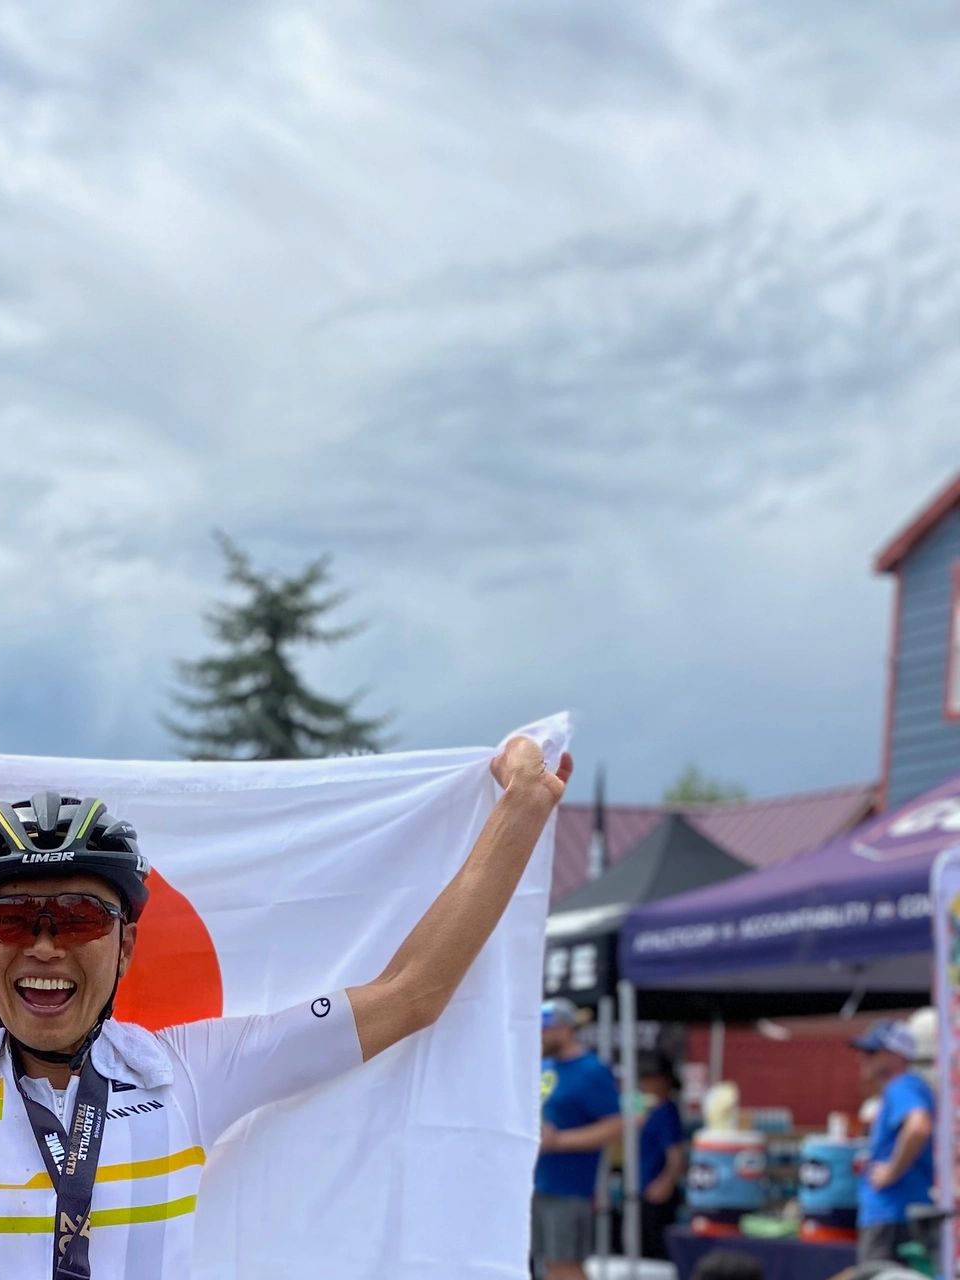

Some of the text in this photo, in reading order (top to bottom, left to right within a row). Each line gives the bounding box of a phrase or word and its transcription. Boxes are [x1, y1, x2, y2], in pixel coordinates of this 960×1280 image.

[21, 851, 75, 865] LIMAR
[73, 1103, 87, 1133] TRAIL
[106, 1099, 165, 1120] ANYON
[77, 1104, 96, 1161] LEADVILLE
[65, 1150, 79, 1176] MTB
